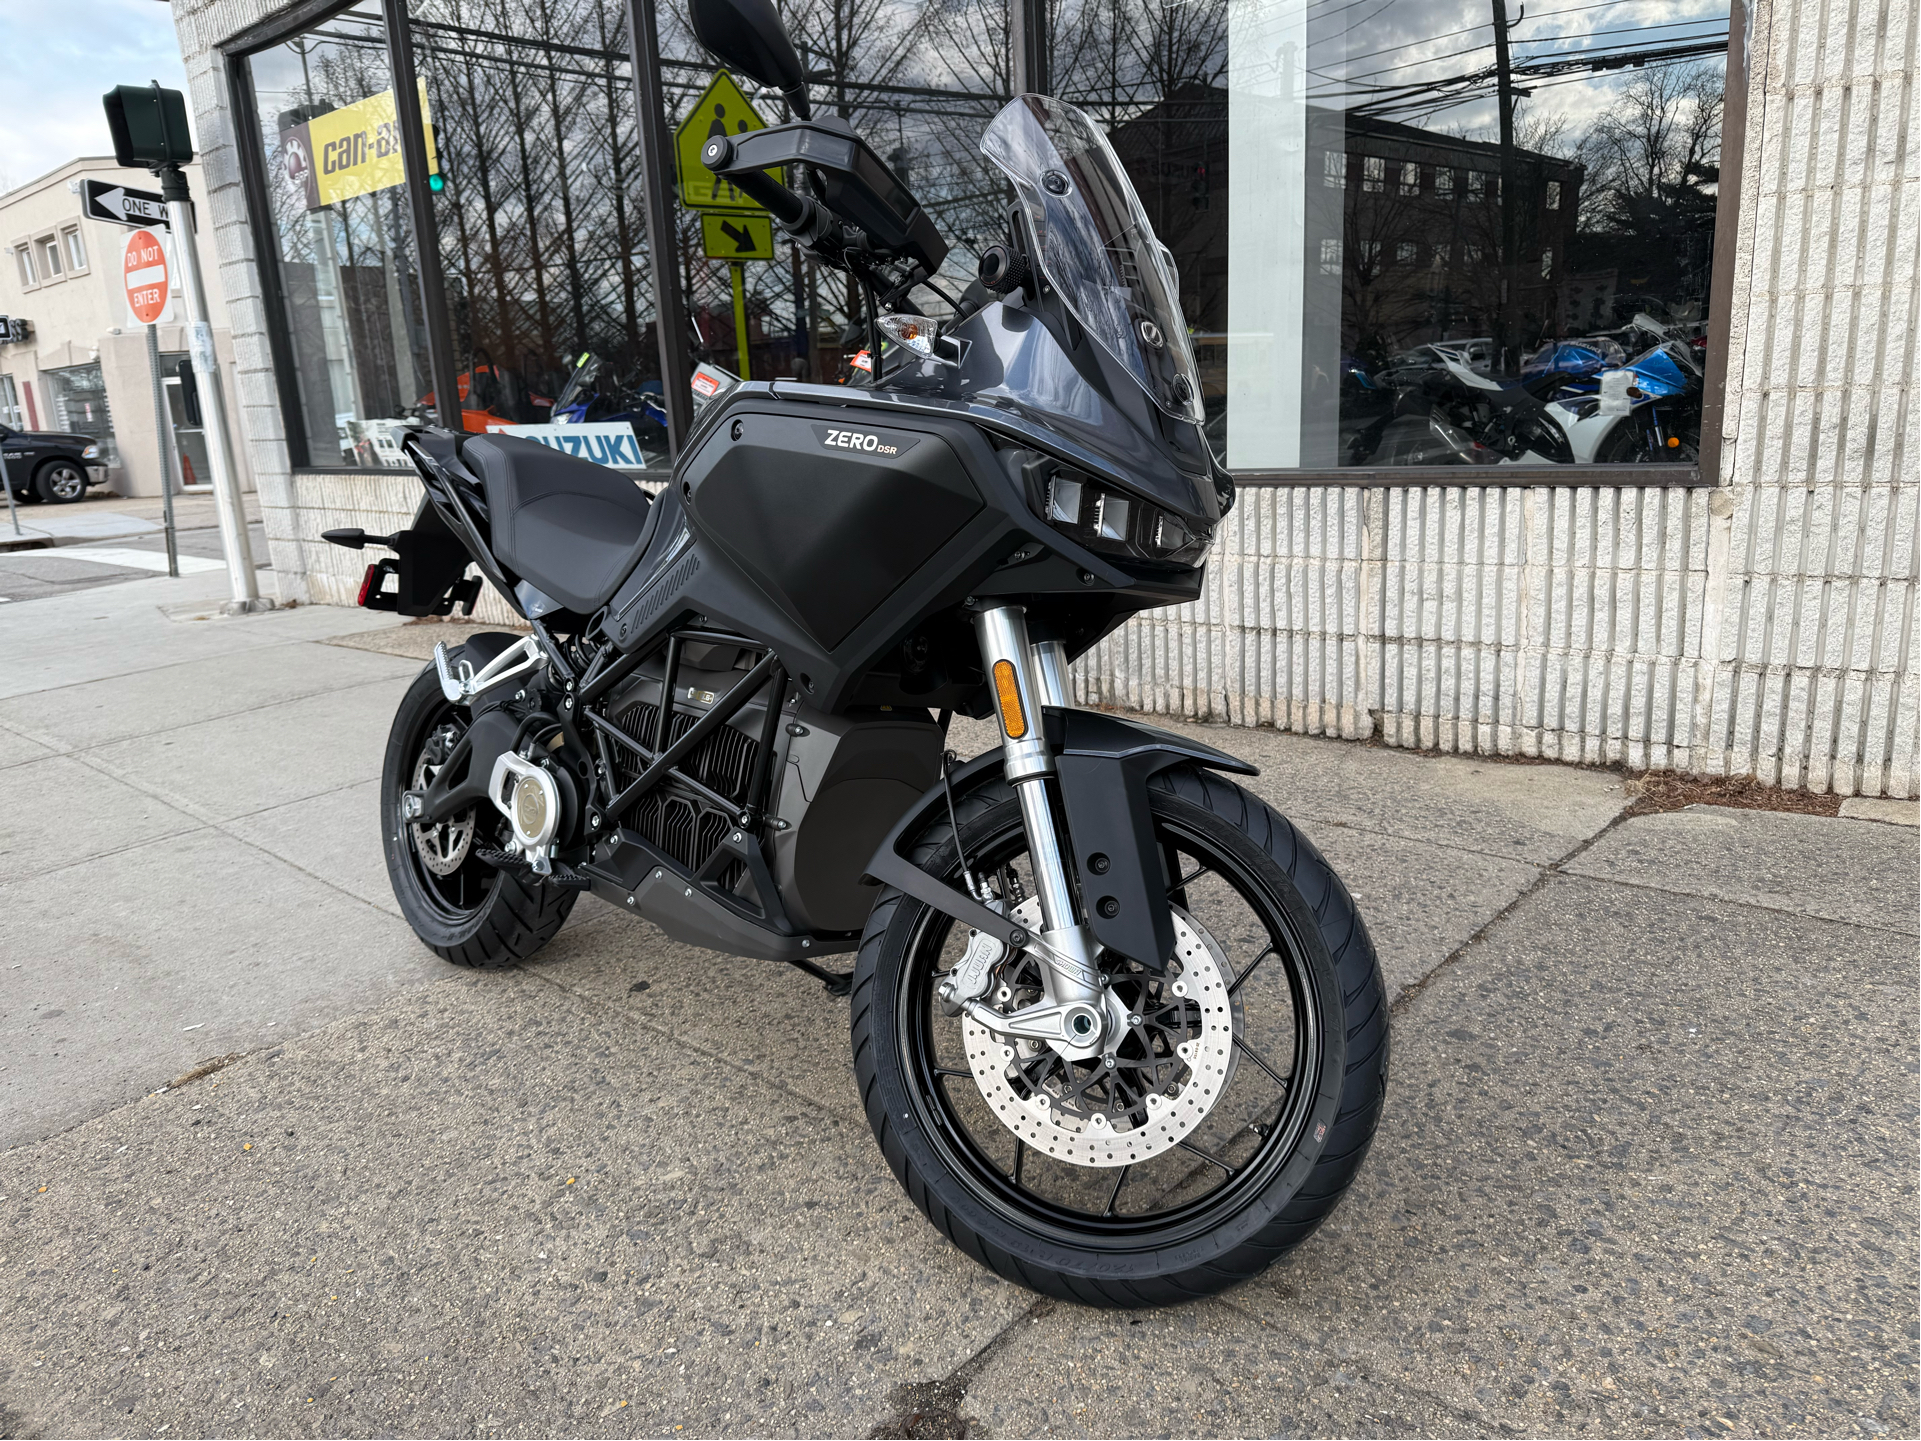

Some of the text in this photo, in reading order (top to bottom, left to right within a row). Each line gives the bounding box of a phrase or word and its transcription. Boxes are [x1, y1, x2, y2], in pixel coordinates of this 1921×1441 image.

[122, 197, 152, 216] ONE
[127, 245, 159, 267] DO NOT
[134, 288, 160, 307] ENTER
[824, 429, 898, 455] ZERO DSR
